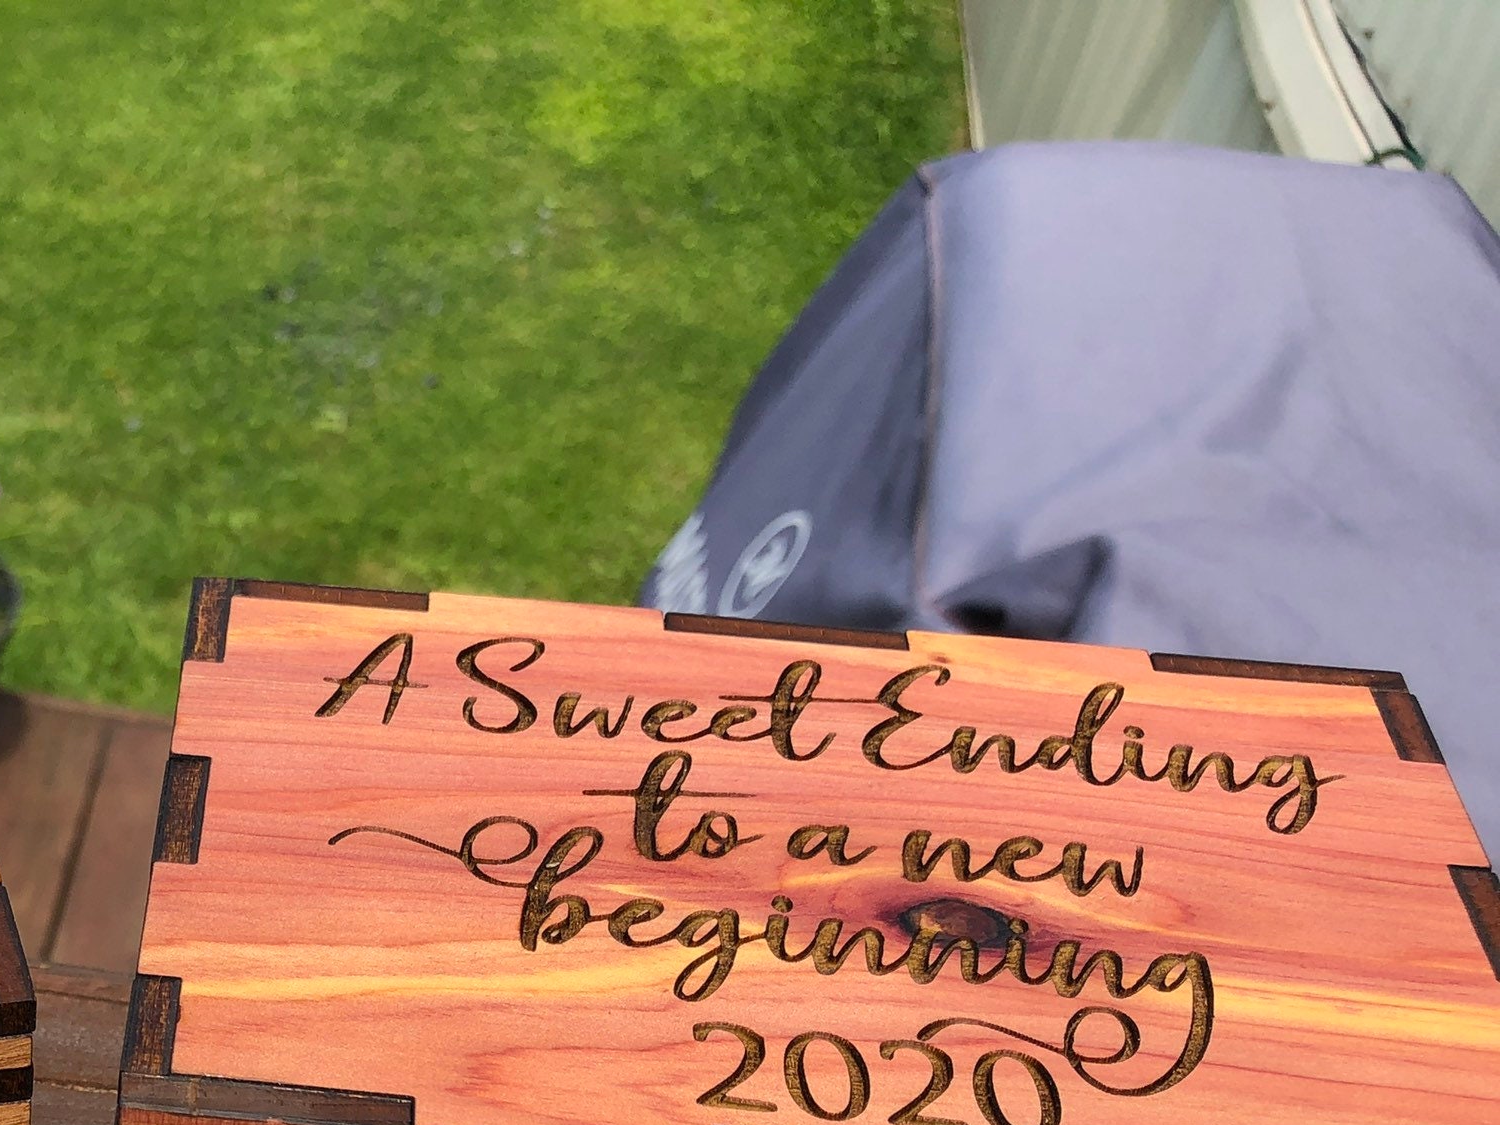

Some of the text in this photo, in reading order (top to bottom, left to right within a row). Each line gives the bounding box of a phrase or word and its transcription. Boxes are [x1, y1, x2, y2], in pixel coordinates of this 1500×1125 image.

[314, 633, 1346, 835] A Sweet Ending
[582, 750, 1143, 898] to a new
[327, 815, 1214, 1097] beginning
